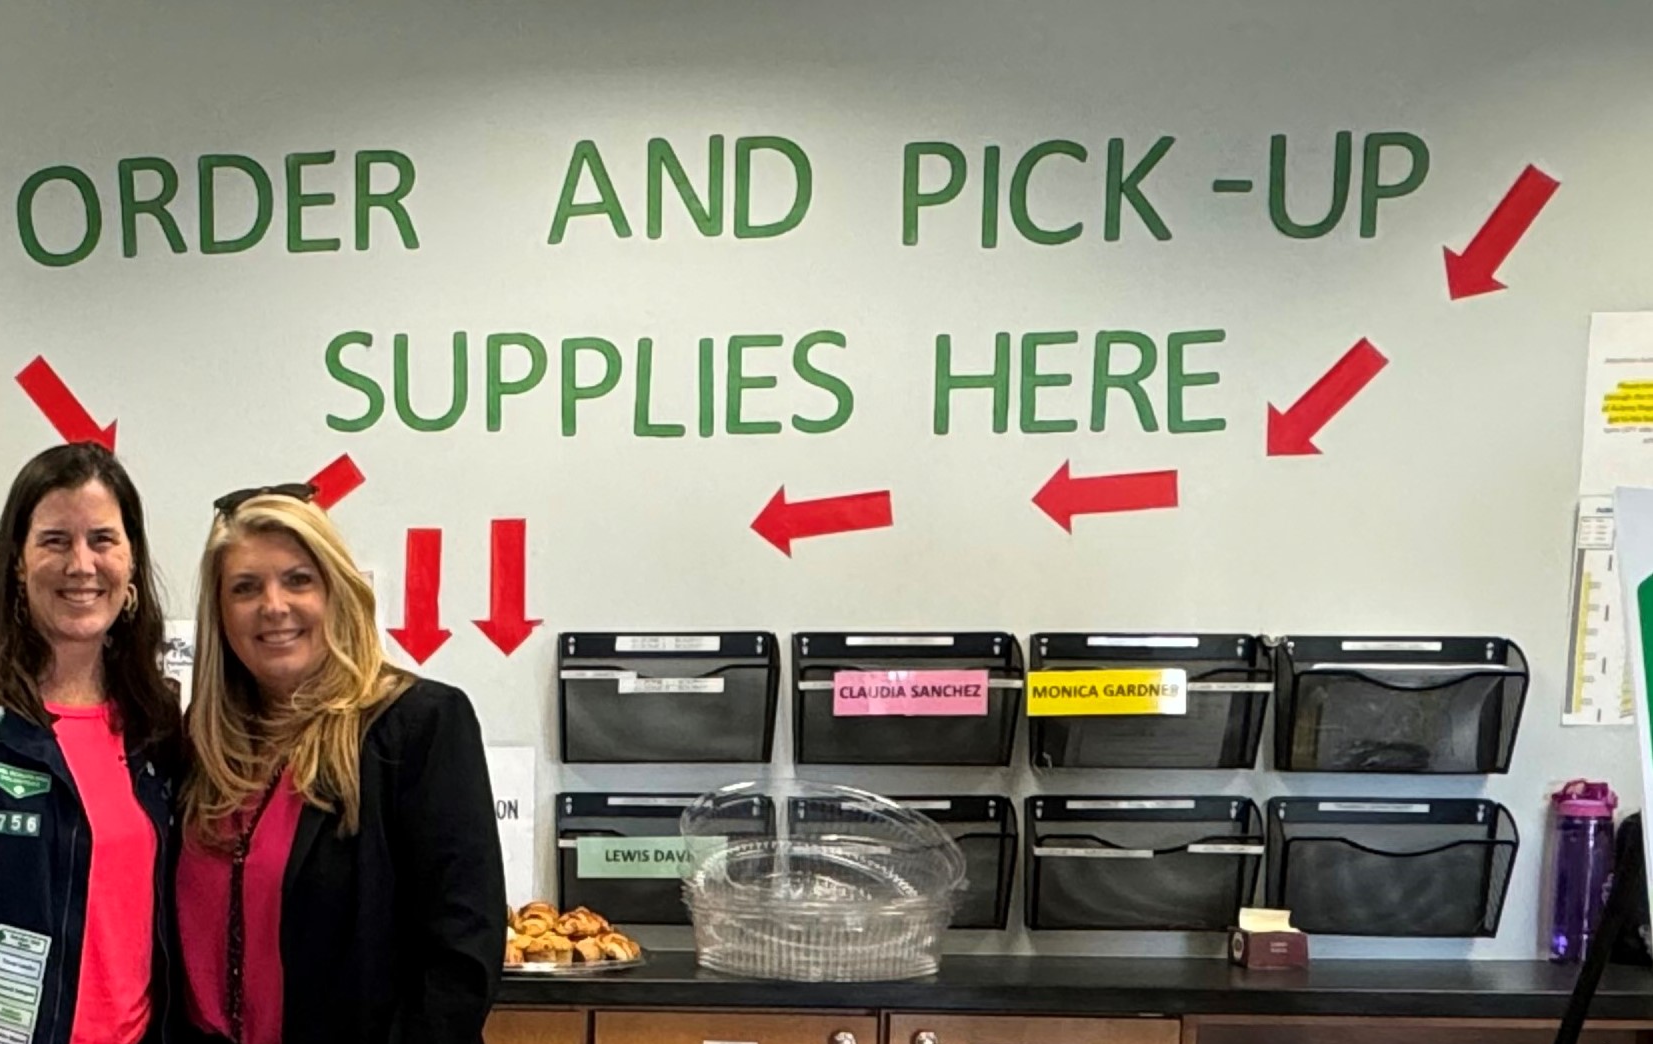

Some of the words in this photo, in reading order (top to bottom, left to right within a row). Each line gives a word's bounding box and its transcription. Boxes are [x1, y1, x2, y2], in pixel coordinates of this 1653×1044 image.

[15, 149, 420, 267] ORDER
[547, 134, 813, 245] AND
[325, 330, 854, 438] SUPPLIES
[933, 328, 1227, 436] HERE
[839, 685, 906, 699] CLAUDIA
[910, 683, 982, 699] SANCHEZ
[1031, 684, 1099, 699] MONICA
[604, 848, 650, 864] LEWIS
